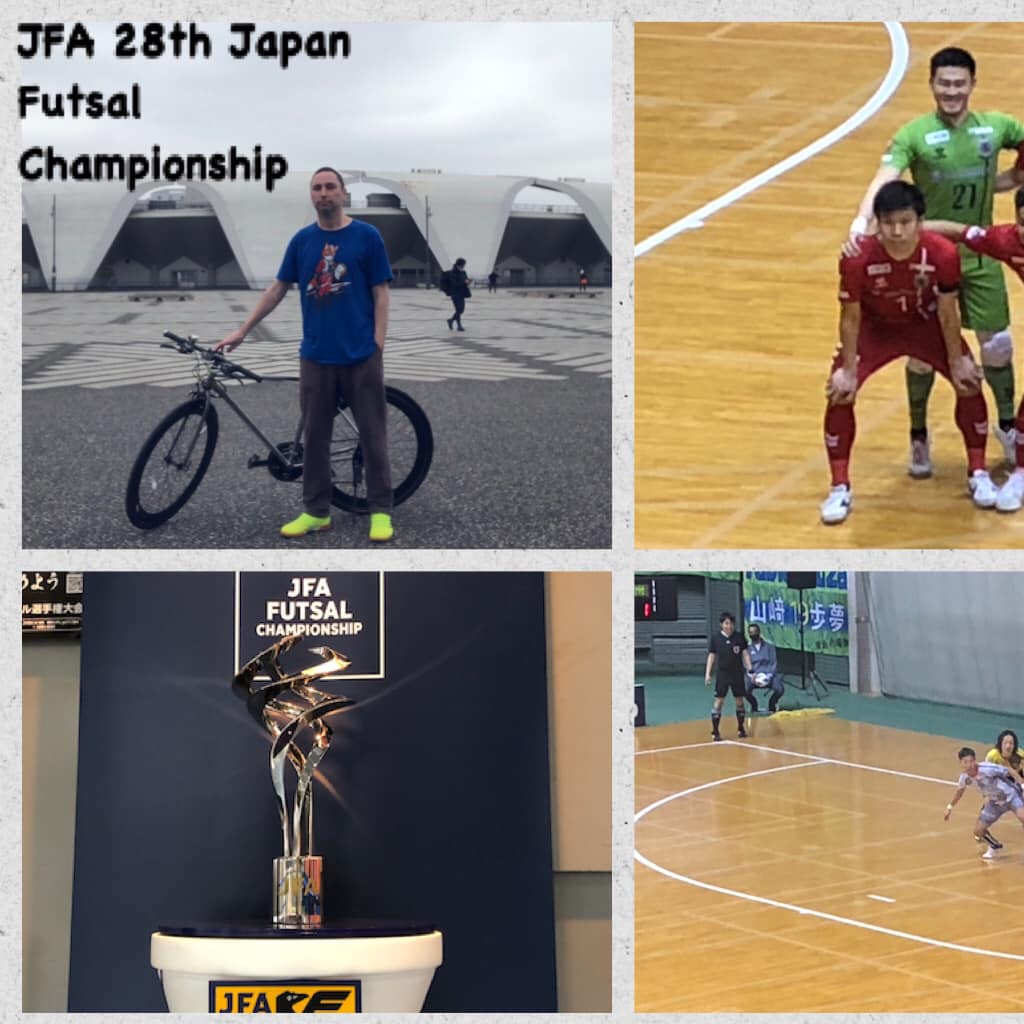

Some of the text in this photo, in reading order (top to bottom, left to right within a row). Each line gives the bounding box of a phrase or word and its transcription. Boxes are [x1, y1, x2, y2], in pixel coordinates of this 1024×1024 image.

[952, 183, 976, 210] 21
[287, 577, 332, 598] JFA
[266, 600, 353, 620] FUTSAL
[255, 621, 363, 637] CHAMPIONSHIP
[219, 992, 272, 1013] JFA
